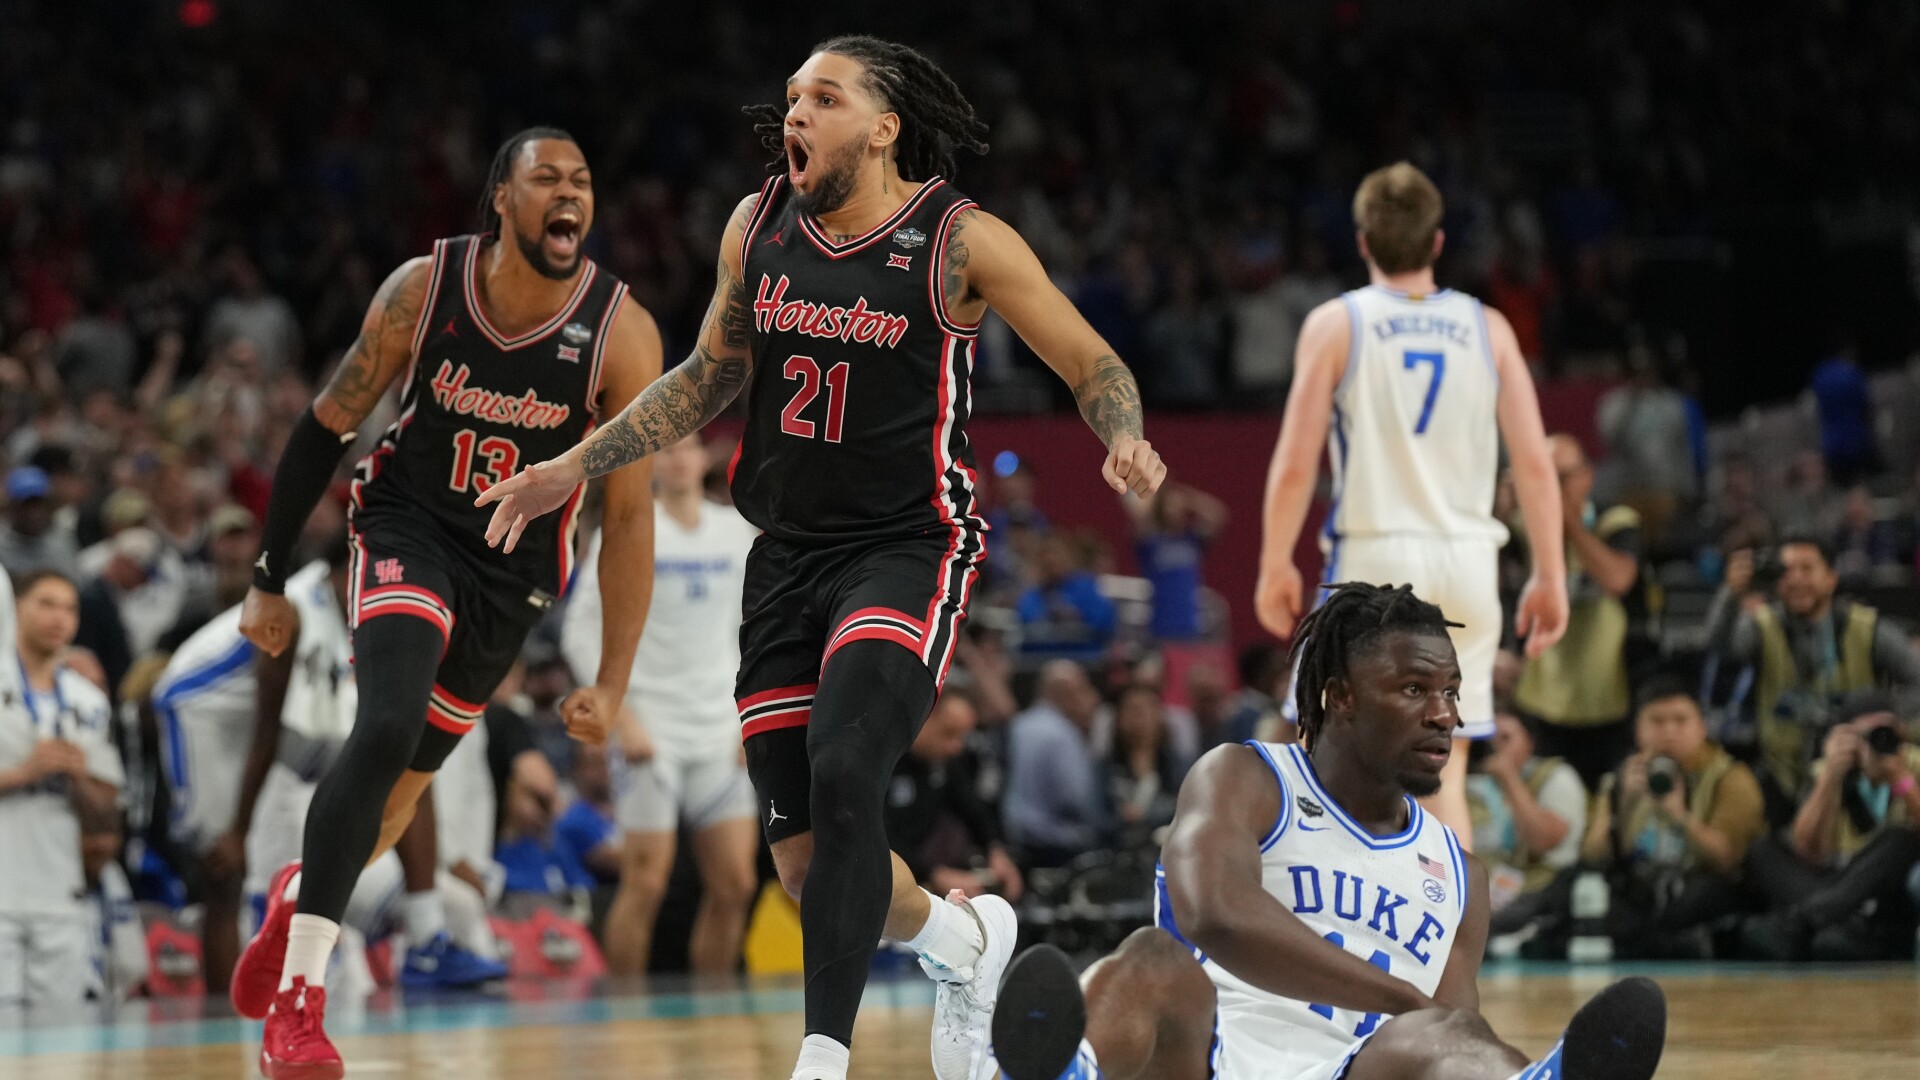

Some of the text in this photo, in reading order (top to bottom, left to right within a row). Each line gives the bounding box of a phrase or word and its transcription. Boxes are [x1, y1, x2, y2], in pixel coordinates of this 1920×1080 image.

[754, 273, 909, 350] Houston
[431, 358, 570, 429] Houston
[781, 354, 850, 443] 21
[1403, 351, 1445, 435] 7
[449, 428, 521, 496] 13
[1288, 865, 1445, 966] DUKE
